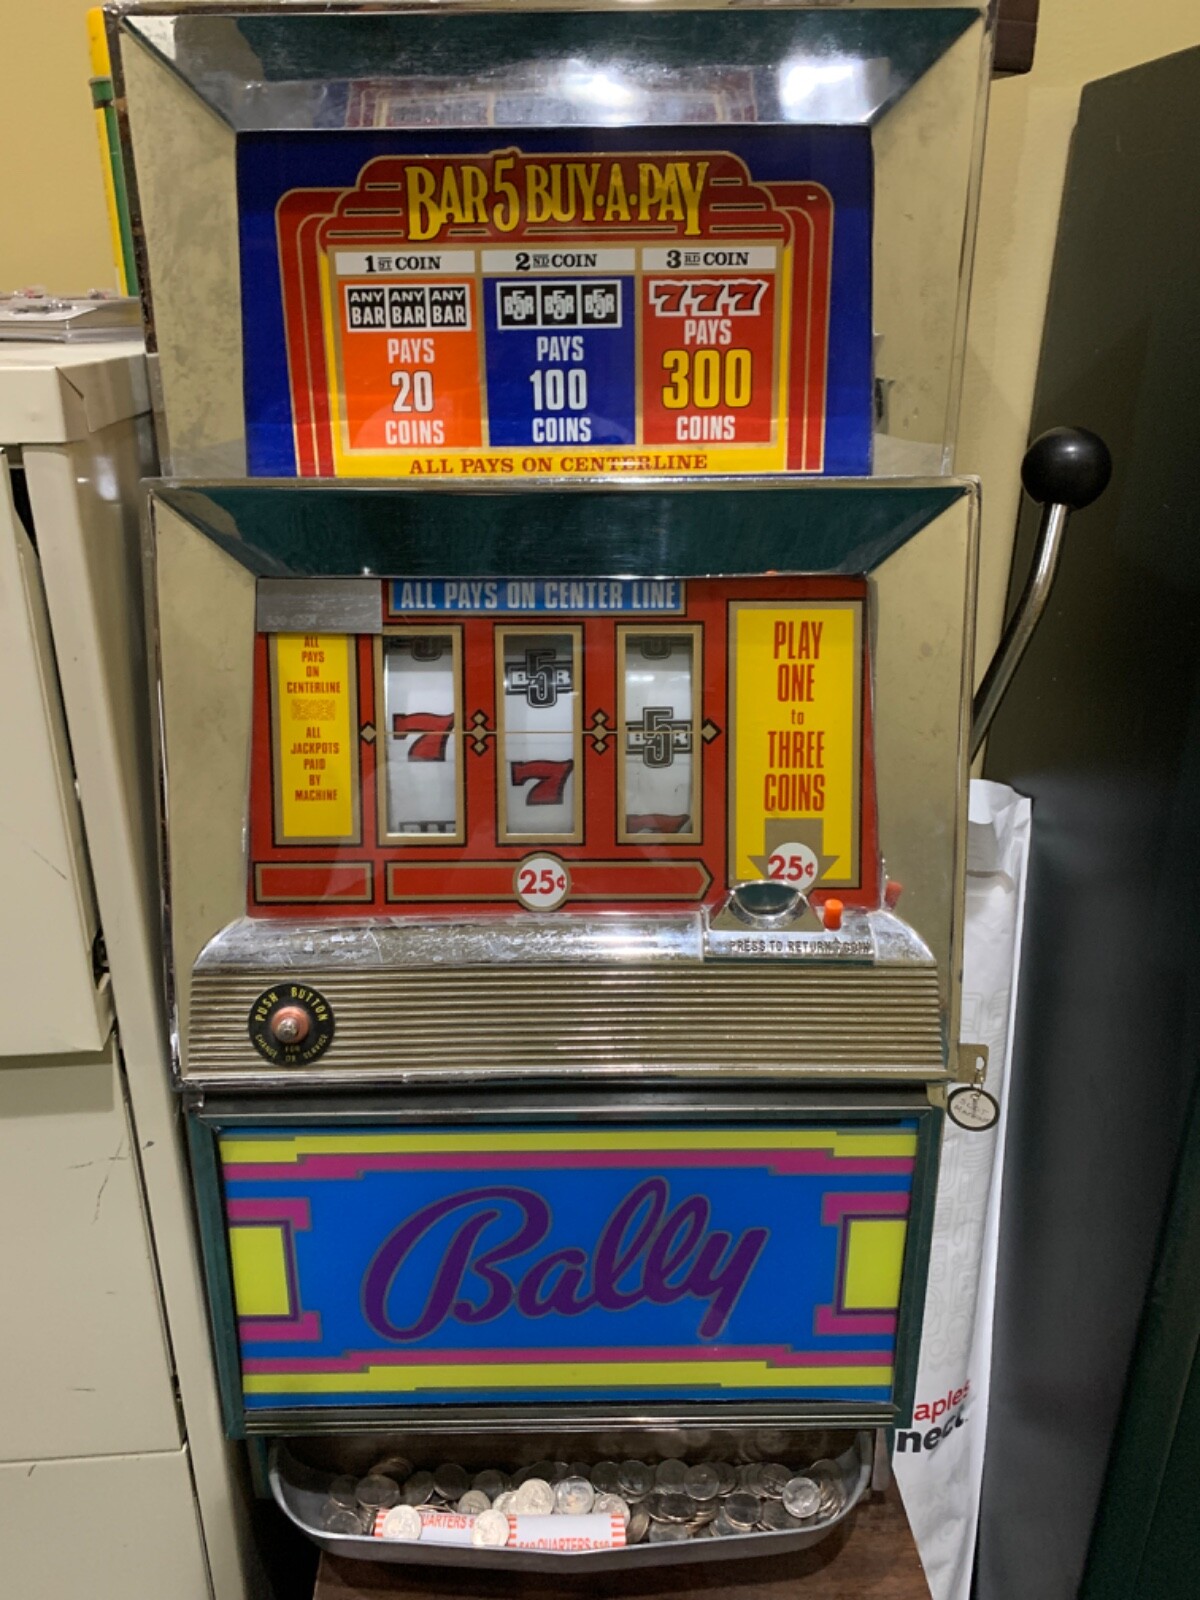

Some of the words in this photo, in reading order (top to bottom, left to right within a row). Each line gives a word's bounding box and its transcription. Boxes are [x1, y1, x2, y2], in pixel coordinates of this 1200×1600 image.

[404, 165, 489, 240] BAR
[493, 157, 520, 232] 5
[395, 256, 441, 270] COIN
[551, 254, 597, 268] COIN
[703, 252, 749, 266] COIN
[350, 291, 383, 302] ANY
[390, 291, 424, 302] ANY
[431, 290, 464, 301] ANY
[351, 306, 385, 325] BAR
[391, 306, 425, 325] BAR
[432, 305, 466, 324] BAR
[684, 319, 732, 345] PAYS
[387, 338, 435, 364] PAYS
[536, 336, 584, 361] PAYS
[529, 368, 588, 411] 100
[661, 348, 753, 410] 300
[391, 370, 434, 413] 20
[385, 420, 445, 445] COINS
[532, 417, 592, 442] COINS
[676, 415, 736, 441] COINS
[410, 459, 454, 474] ALL
[460, 458, 514, 473] PAYS
[522, 457, 553, 472] ON
[560, 454, 707, 472] CENTERLINE
[401, 582, 436, 609] ALL
[444, 582, 498, 609] PAYS
[507, 582, 536, 608] ON
[544, 582, 623, 608] CENTER
[632, 582, 675, 608] LINE
[304, 635, 319, 648] ALL
[773, 621, 823, 659] PLAY
[302, 651, 325, 663] PAYS
[306, 665, 319, 677] ON
[287, 681, 340, 694] CENTERLINE
[777, 664, 815, 702] ONE
[791, 709, 805, 725] to
[306, 727, 321, 739] ALL
[290, 742, 340, 754] JACKPOTS
[767, 731, 825, 769] THREE
[304, 758, 326, 770] PAID
[309, 774, 321, 786] BY
[294, 789, 338, 801] MACHINE
[764, 774, 825, 811] COINS
[768, 855, 814, 881] 25¢
[520, 869, 566, 895] 25¢
[730, 940, 766, 952] PRESS
[769, 940, 784, 952] TO
[788, 940, 831, 953] RETURN
[255, 992, 279, 1022] PUSH
[291, 986, 329, 1021] BUTTON
[361, 1176, 770, 1342] Bally
[421, 1514, 467, 1529] UARTERS
[538, 1537, 591, 1550] QUARTERS
